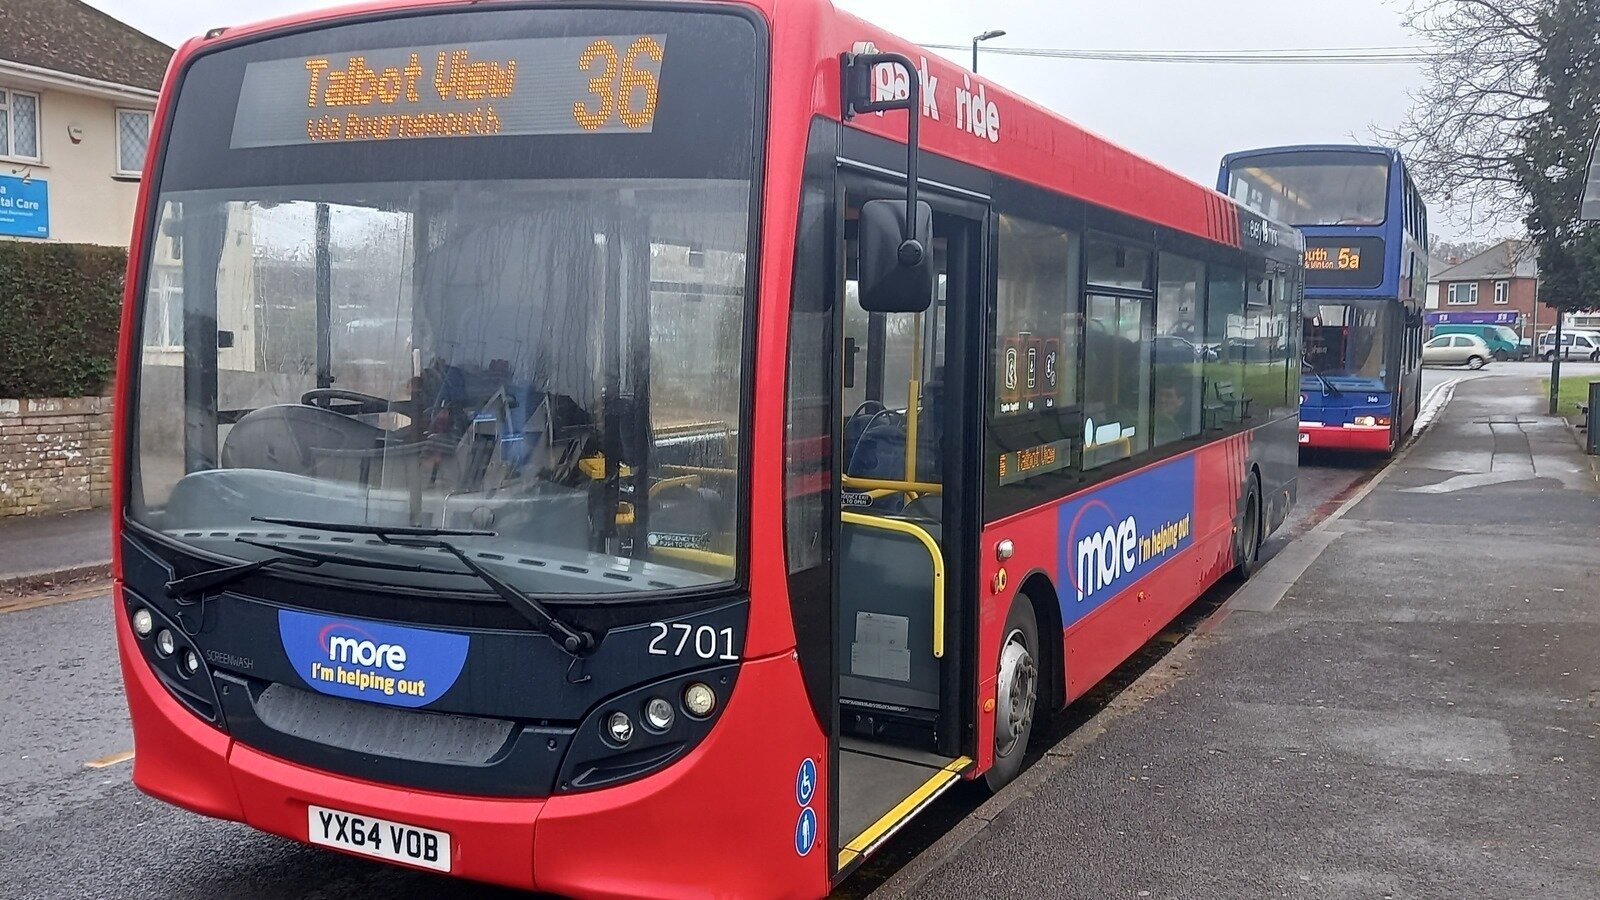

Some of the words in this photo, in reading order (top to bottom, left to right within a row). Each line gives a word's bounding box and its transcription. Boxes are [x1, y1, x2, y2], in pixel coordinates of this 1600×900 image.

[306, 51, 424, 107] Talbot
[433, 49, 516, 100] View
[573, 36, 663, 131] 36
[307, 113, 341, 141] via
[345, 104, 502, 140] Bournemouth
[955, 73, 1000, 143] ride
[16, 198, 39, 210] Care
[1338, 247, 1360, 269] 5a
[1077, 515, 1137, 602] more
[1151, 521, 1179, 557] helping
[1178, 512, 1190, 541] out
[206, 649, 254, 670] SCREENWASH
[329, 636, 407, 671] more
[648, 621, 739, 660] 2701
[311, 662, 335, 683] I'm
[336, 666, 396, 696] helping
[397, 679, 426, 697] out
[318, 810, 382, 850] YX64
[389, 825, 438, 862] VOB
